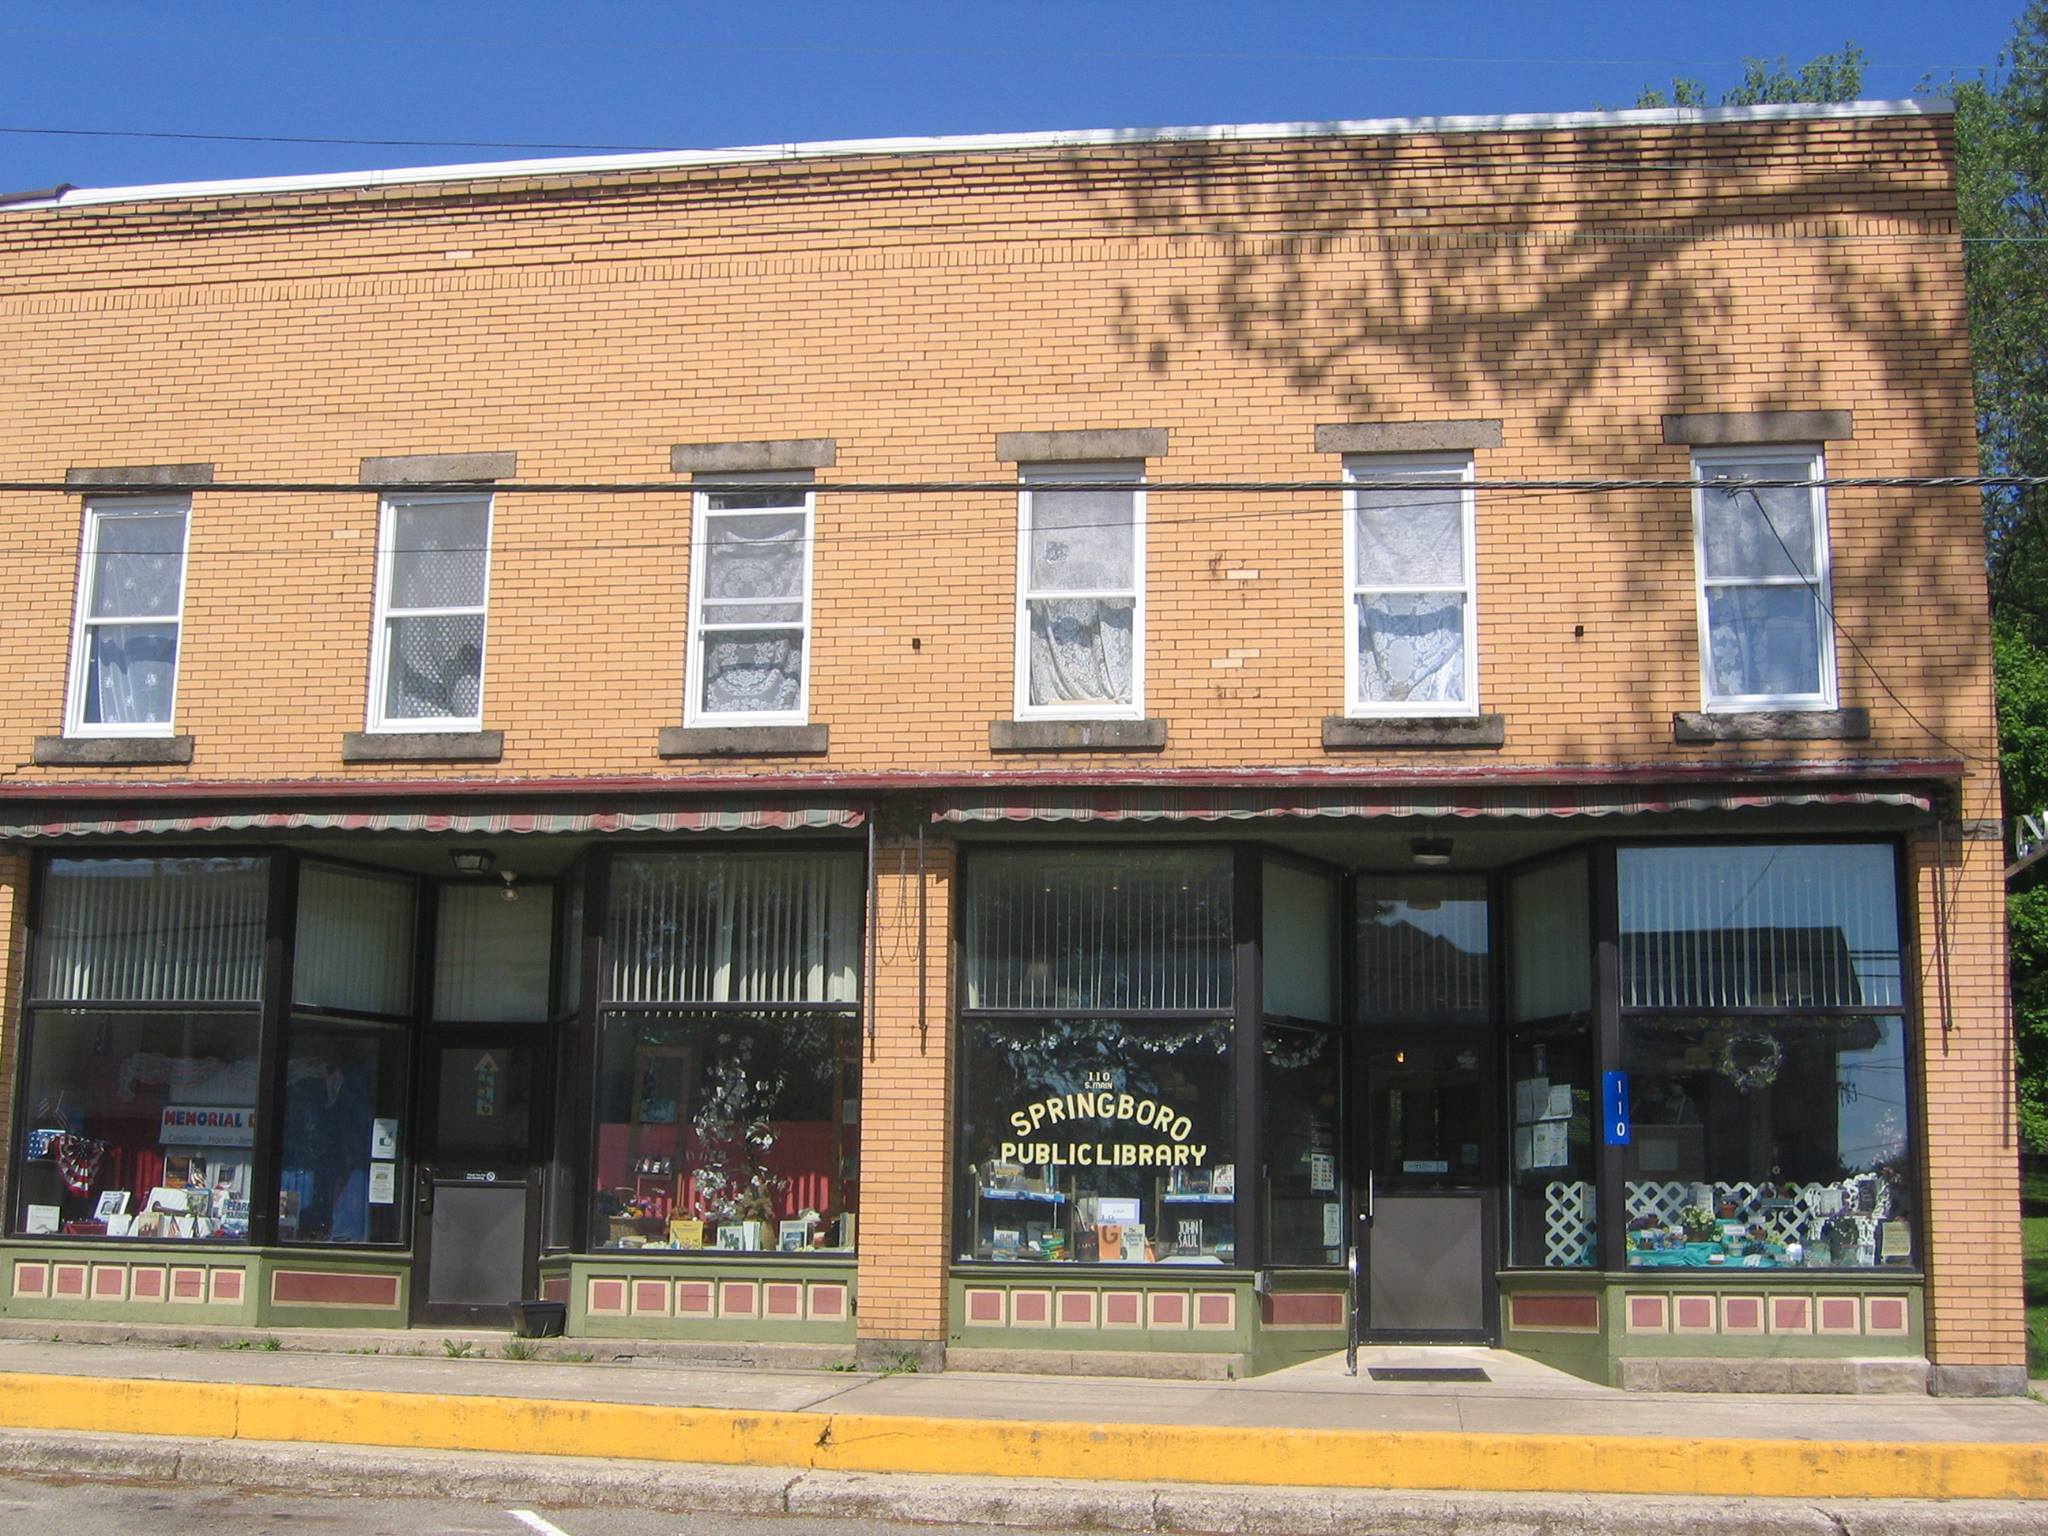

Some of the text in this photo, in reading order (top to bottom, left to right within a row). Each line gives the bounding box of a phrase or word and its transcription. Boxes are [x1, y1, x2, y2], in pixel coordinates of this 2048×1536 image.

[1088, 1071, 1111, 1081] 110
[1010, 1092, 1192, 1142] SPRINGBORO
[1617, 1080, 1625, 1136] 110
[164, 1110, 242, 1128] MEMORIAL
[1001, 1142, 1207, 1167] PUBLIC LIBRARY
[1178, 1220, 1199, 1235] JOHN
[1178, 1232, 1199, 1248] SAUL
